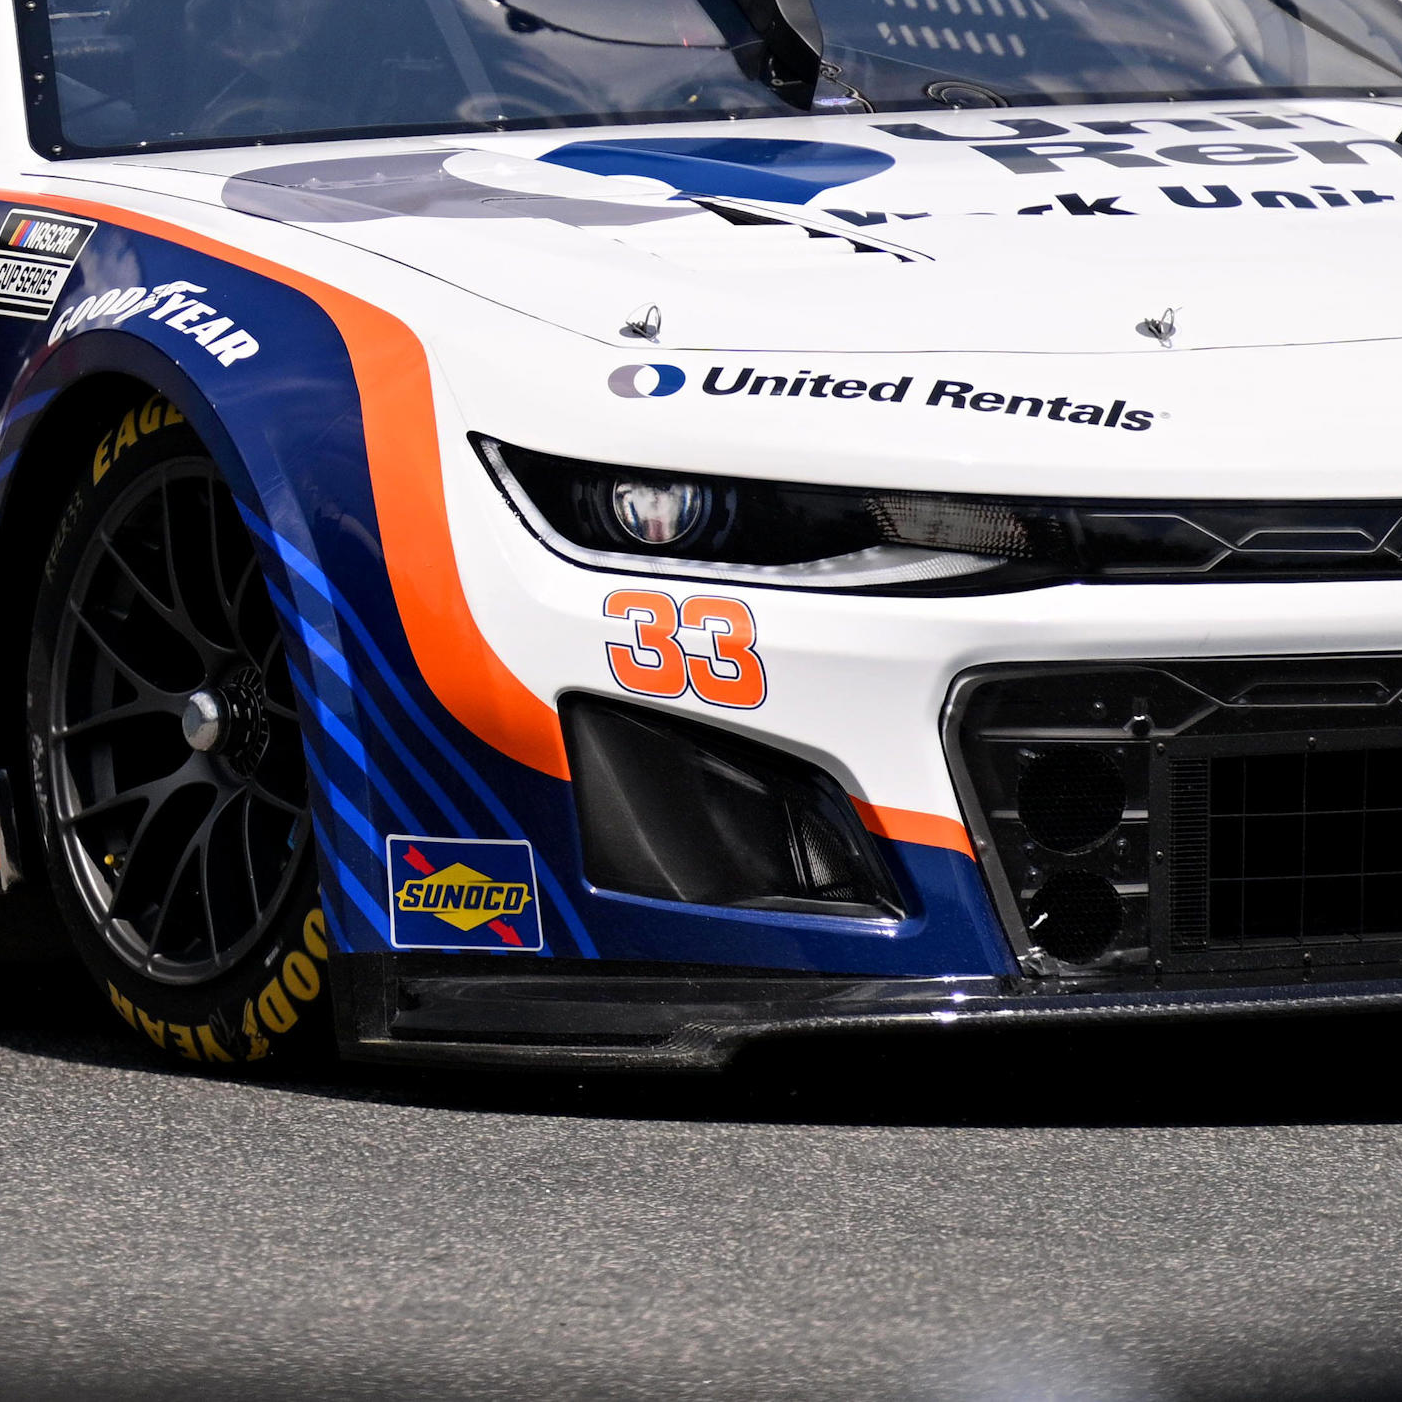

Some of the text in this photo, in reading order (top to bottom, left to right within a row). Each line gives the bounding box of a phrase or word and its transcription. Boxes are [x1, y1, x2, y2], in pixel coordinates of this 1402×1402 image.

[23, 221, 80, 254] NASCAR
[16, 266, 58, 295] SERIES
[48, 280, 260, 368] GOODYEAR
[701, 366, 1156, 432] United Rentals
[93, 393, 184, 487] EAGL
[603, 588, 768, 711] 33
[402, 883, 525, 911] SUNOCO
[106, 907, 329, 1063] OODYEAR
